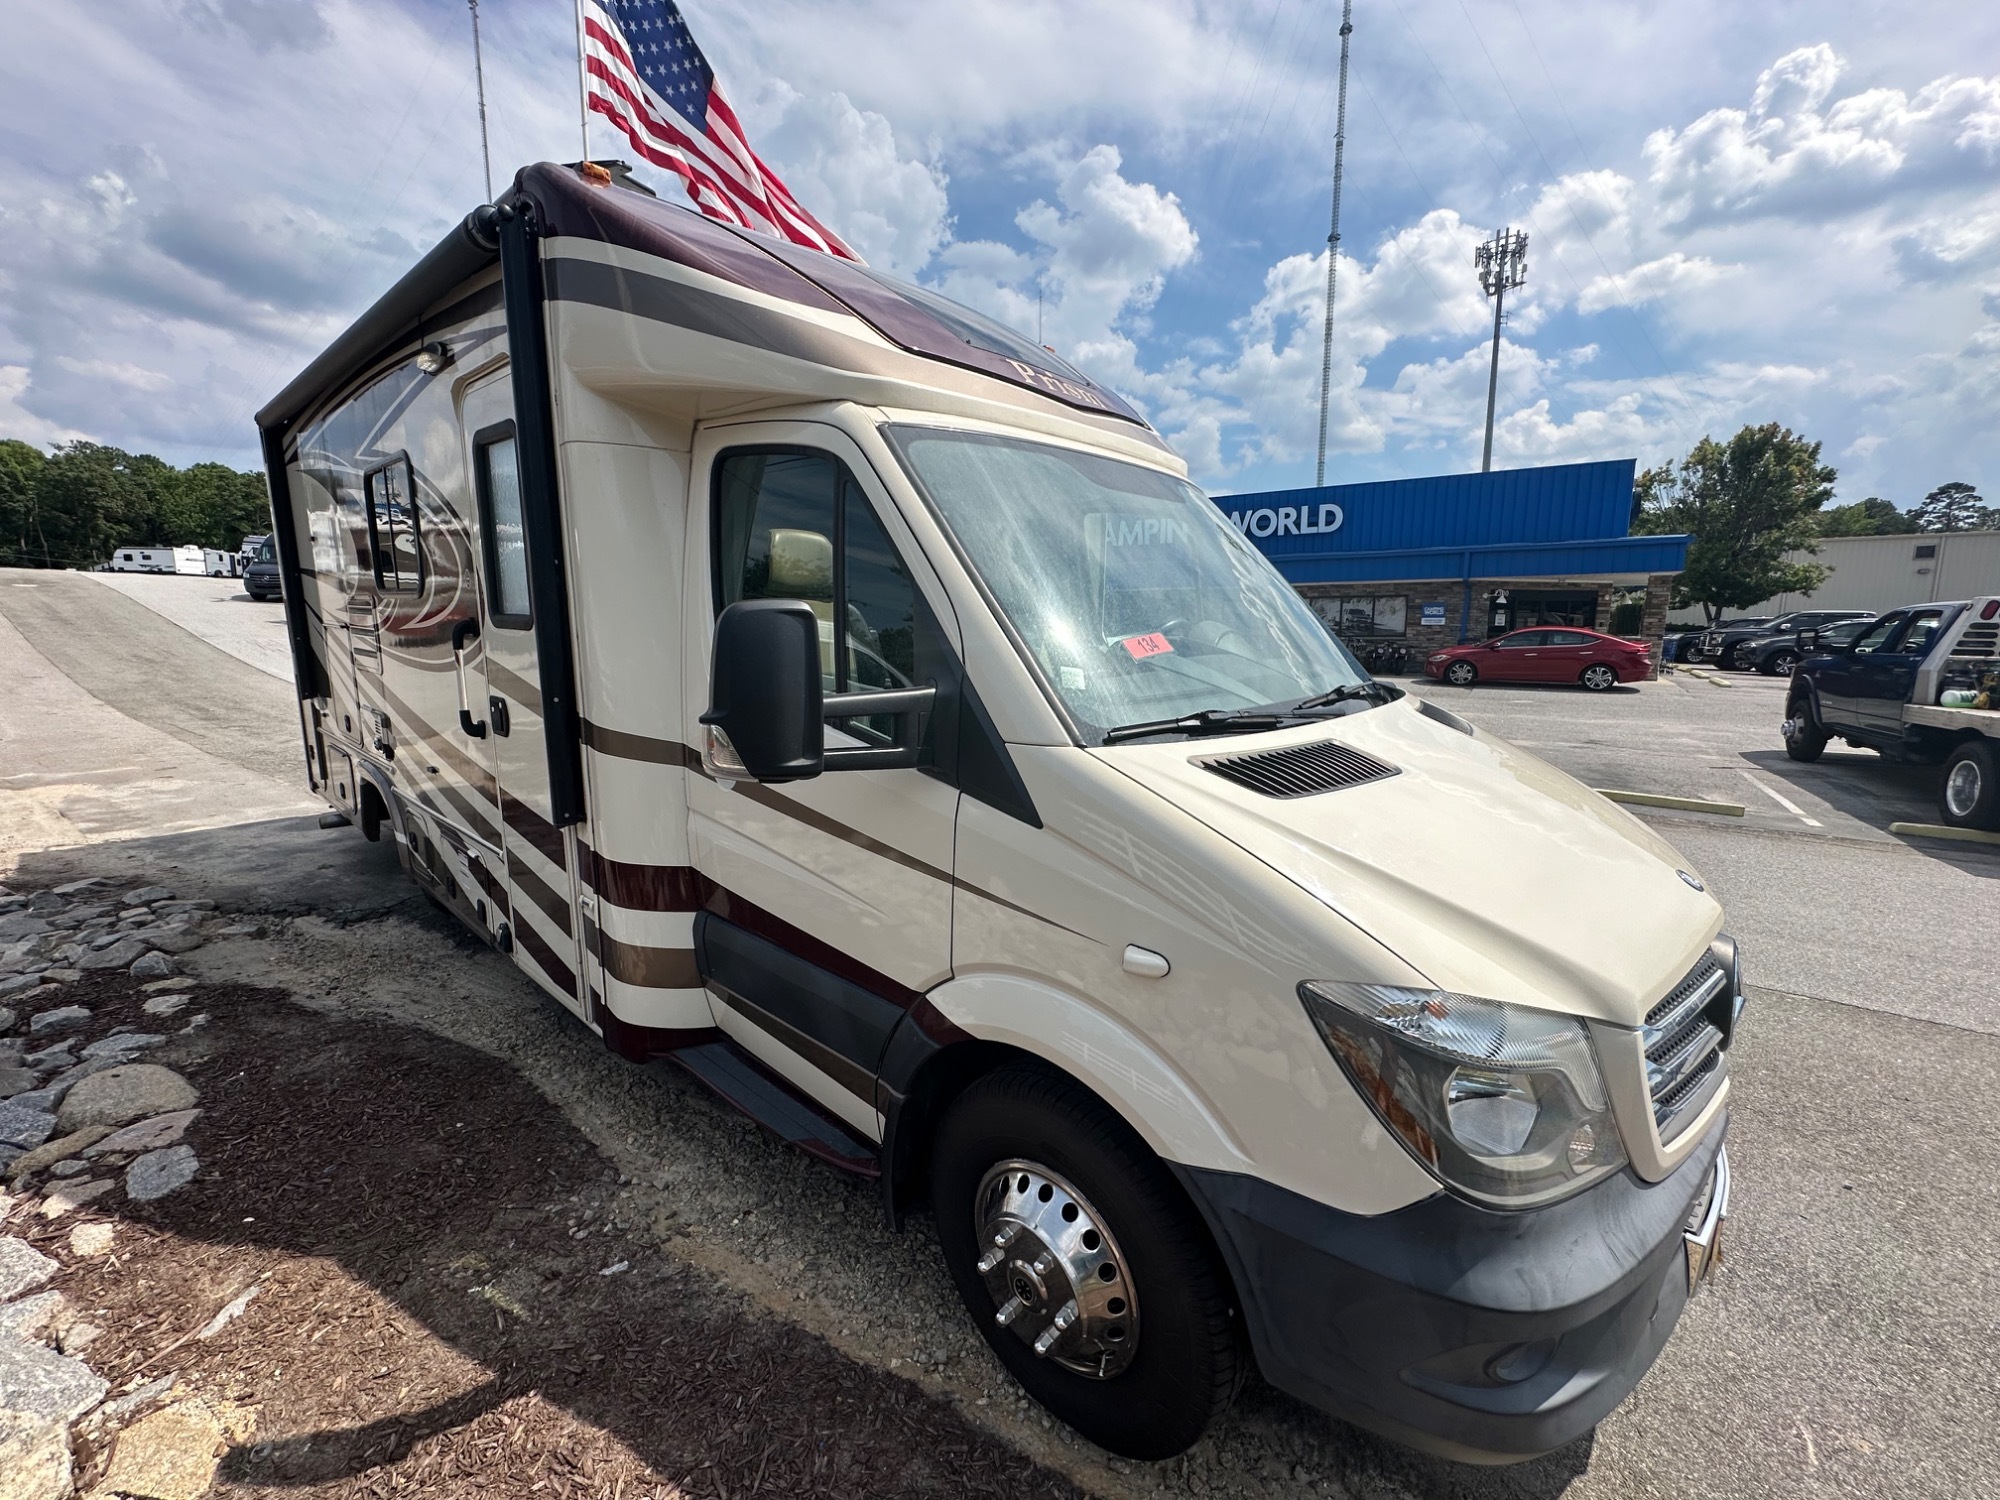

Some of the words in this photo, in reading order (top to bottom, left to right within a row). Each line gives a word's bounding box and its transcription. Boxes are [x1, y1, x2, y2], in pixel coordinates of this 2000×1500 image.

[1006, 358, 1108, 410] Prism
[1230, 503, 1343, 538] WORLD
[1137, 636, 1160, 653] 134
